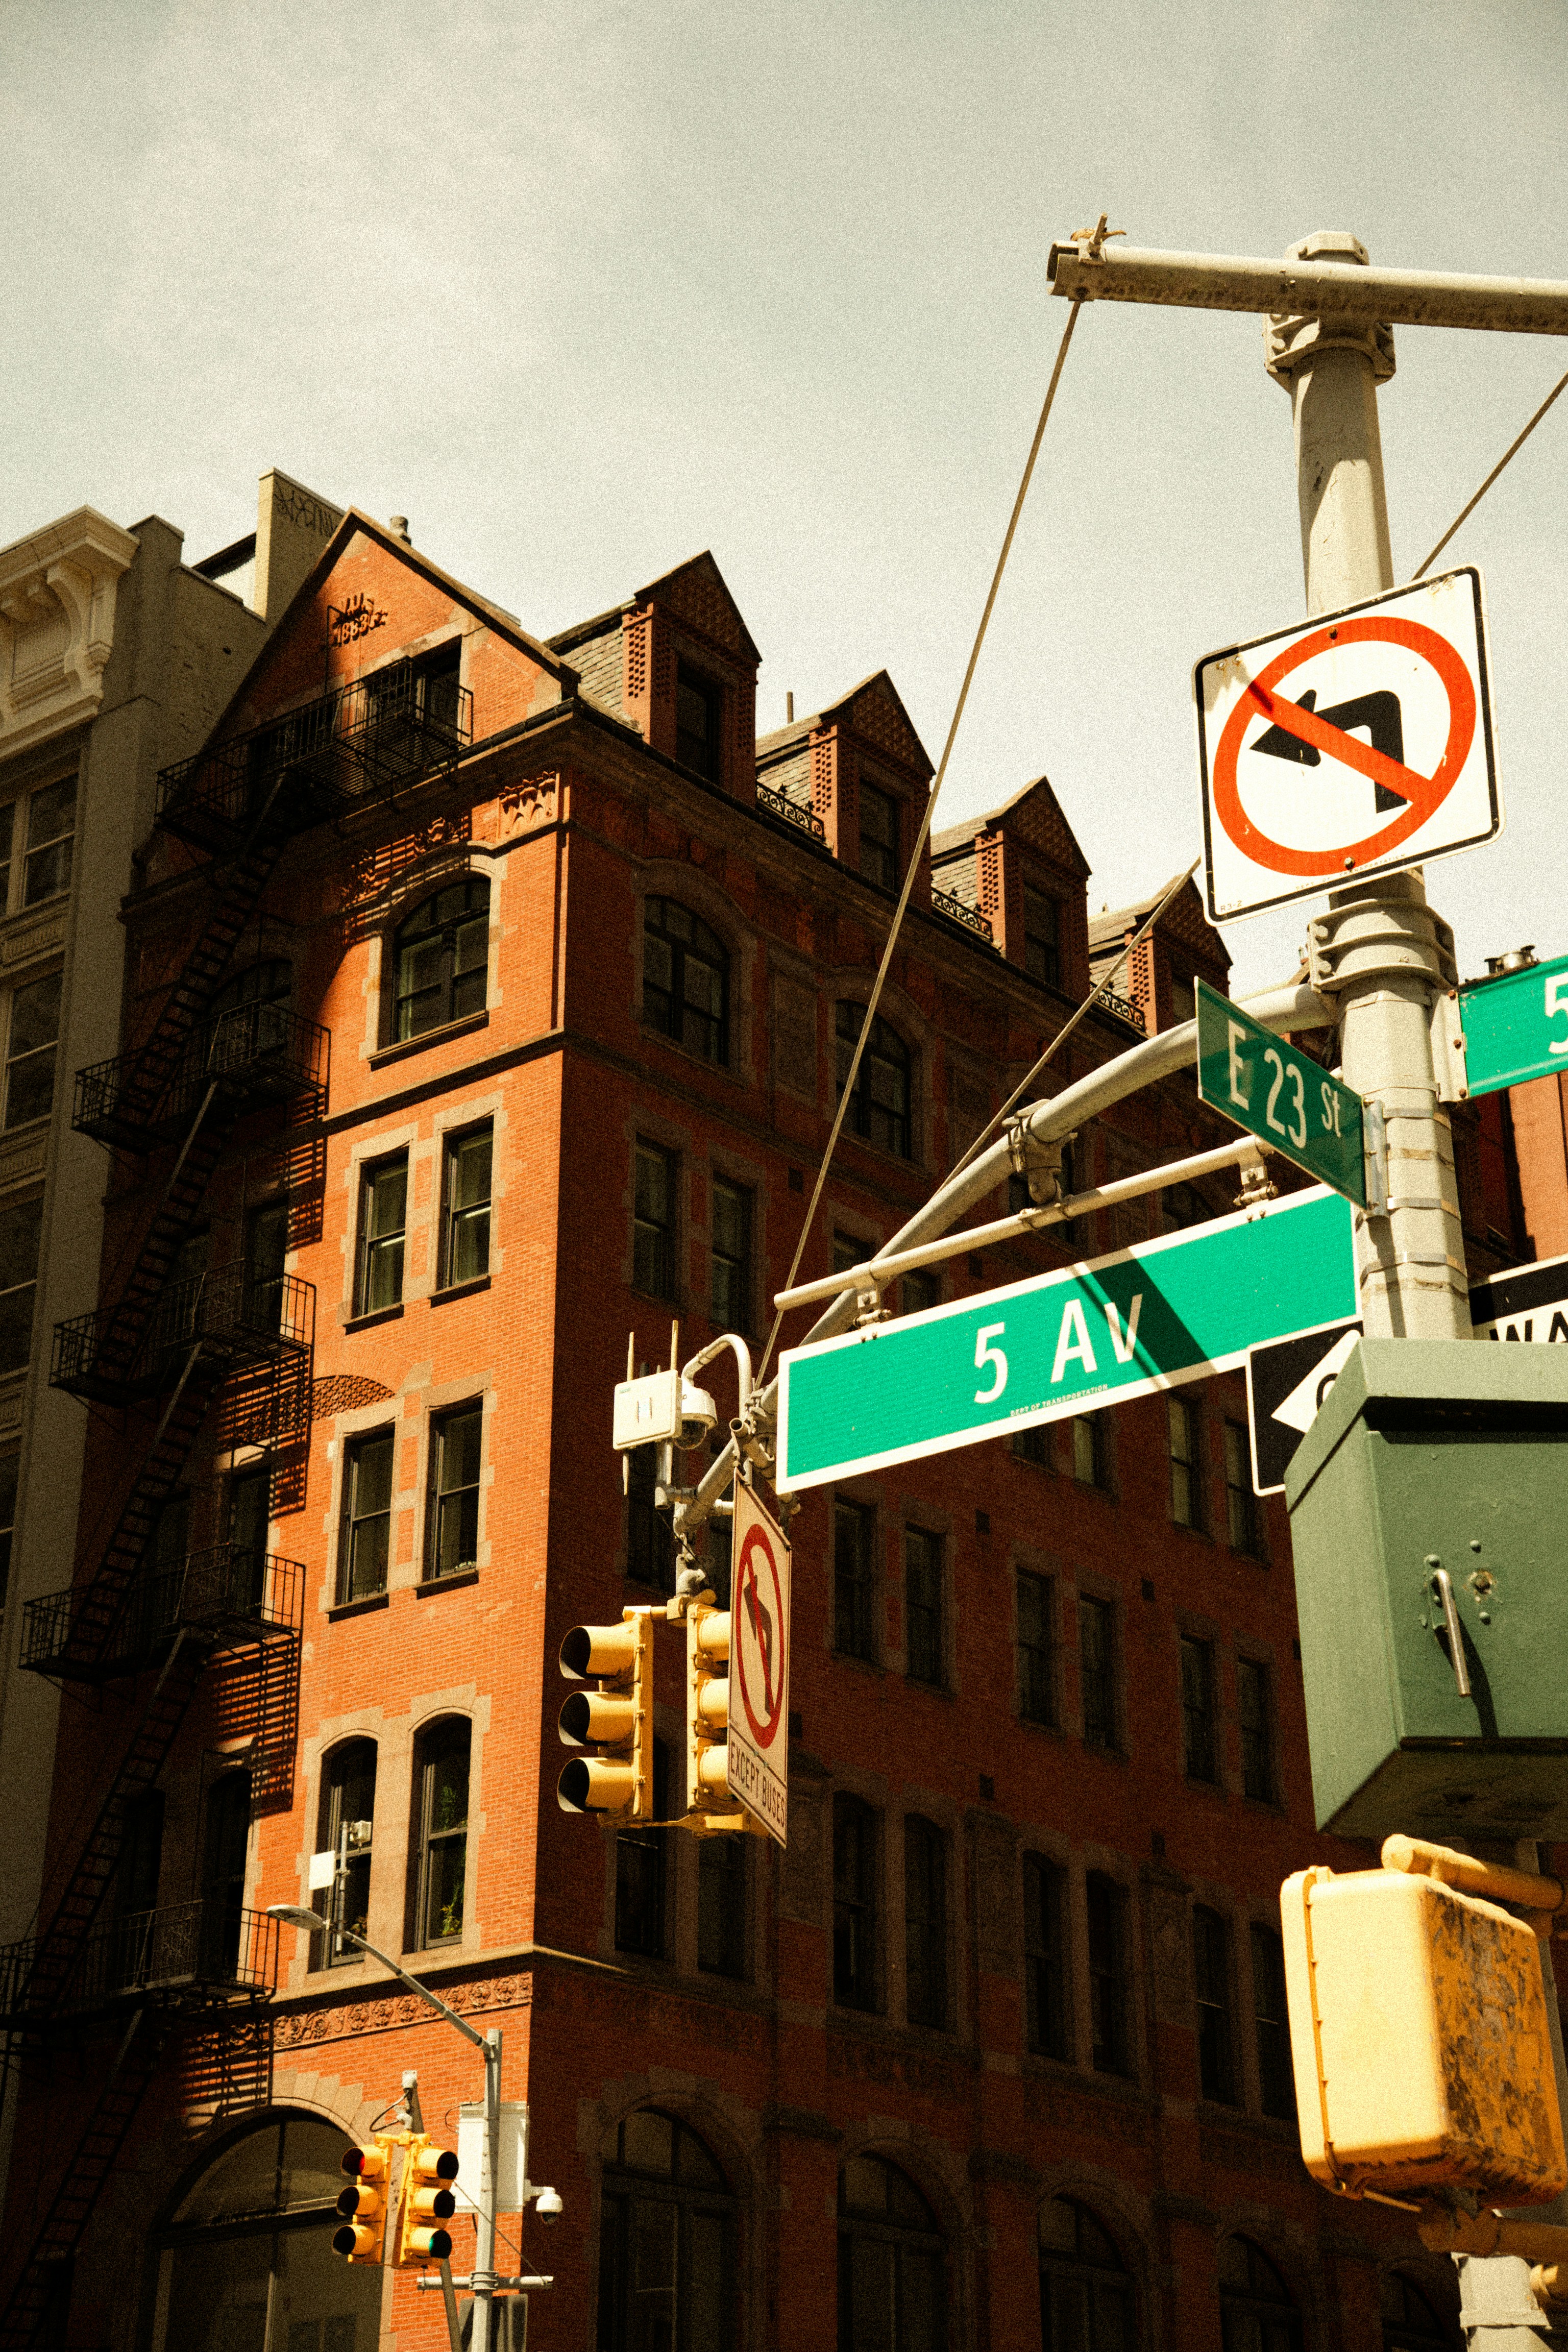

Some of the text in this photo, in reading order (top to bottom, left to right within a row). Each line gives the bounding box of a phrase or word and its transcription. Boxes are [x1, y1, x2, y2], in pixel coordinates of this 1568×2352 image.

[1220, 900, 1242, 912] R3-2
[1545, 971, 1568, 1054] 5
[1228, 1019, 1341, 1149] E 23 St
[974, 1321, 1008, 1405] 5
[1010, 1384, 1108, 1417] DEPT OF TRANSPORTATION
[731, 1739, 785, 1828] EXCEPT BUSES
